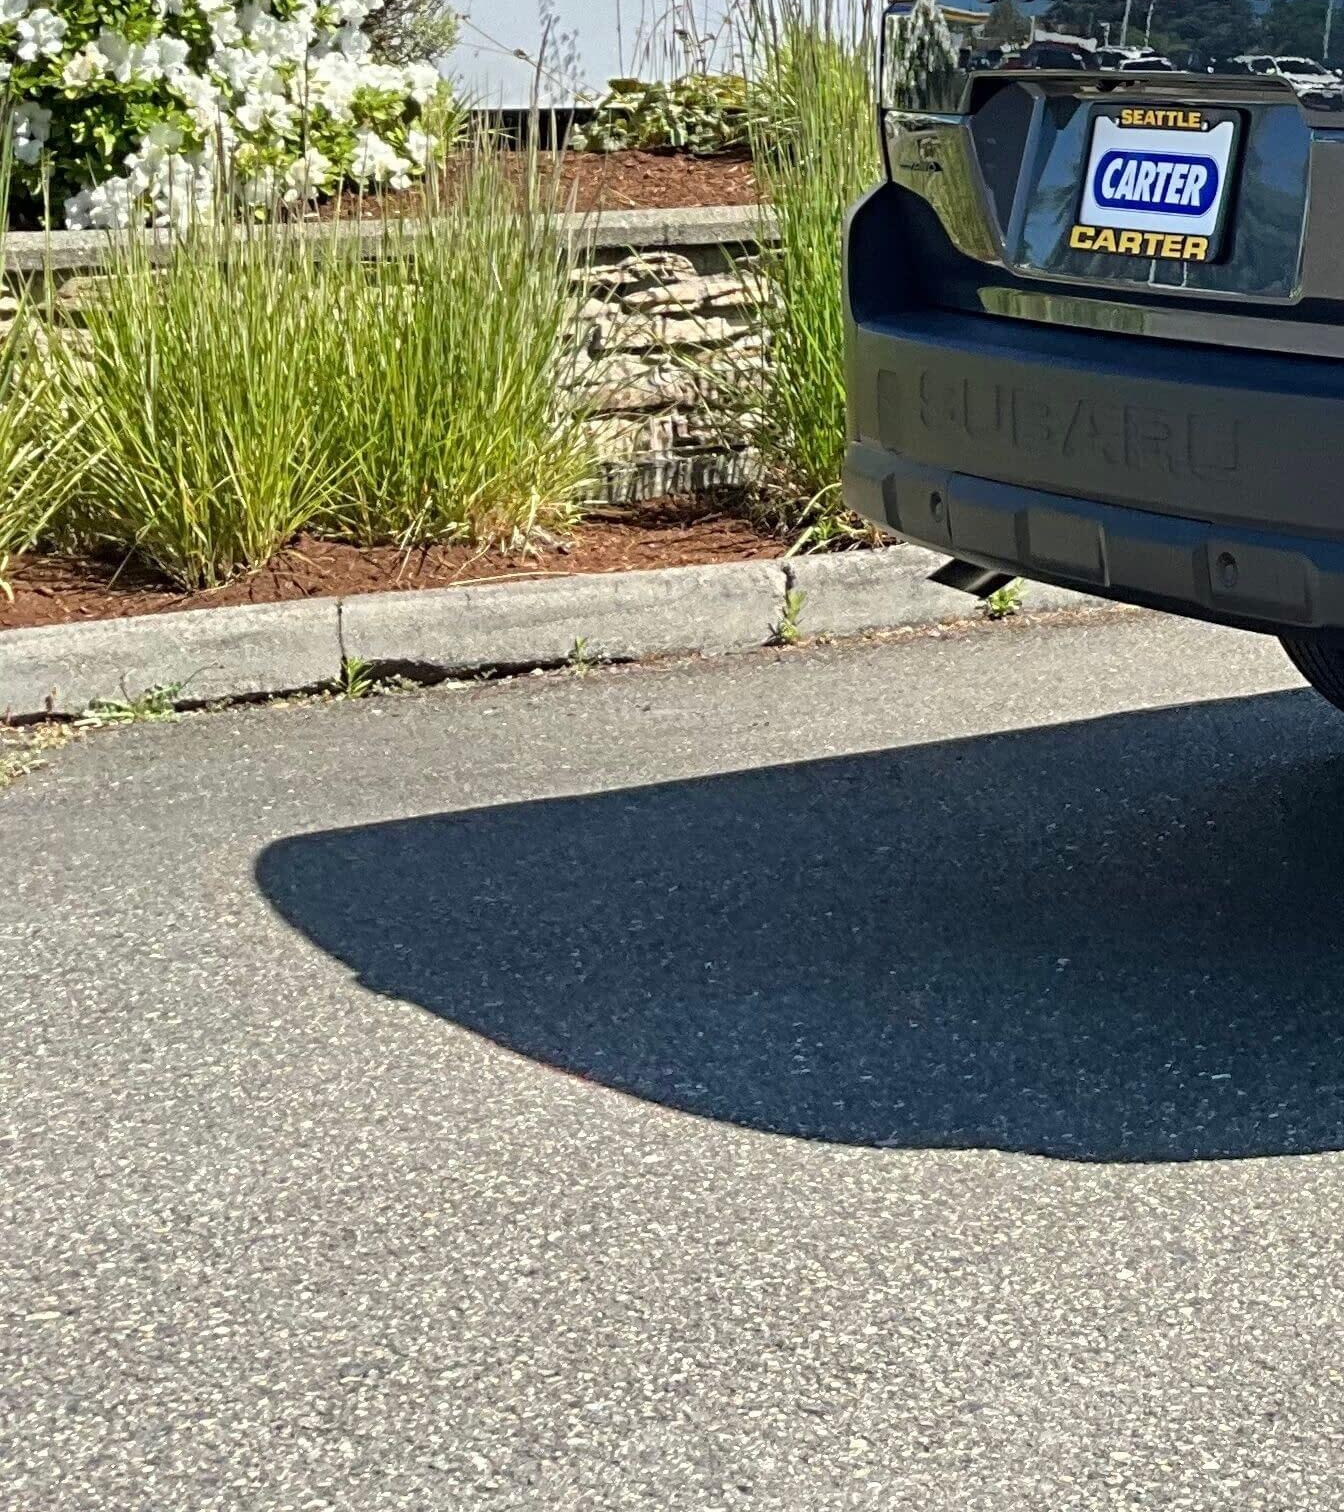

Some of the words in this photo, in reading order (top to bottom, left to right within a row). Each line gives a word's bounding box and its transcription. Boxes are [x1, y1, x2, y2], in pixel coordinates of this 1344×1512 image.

[1121, 109, 1201, 128] SEATTLE
[1101, 157, 1208, 207] CARTER
[1069, 225, 1209, 260] CARTER
[918, 368, 1242, 480] SUBARU
